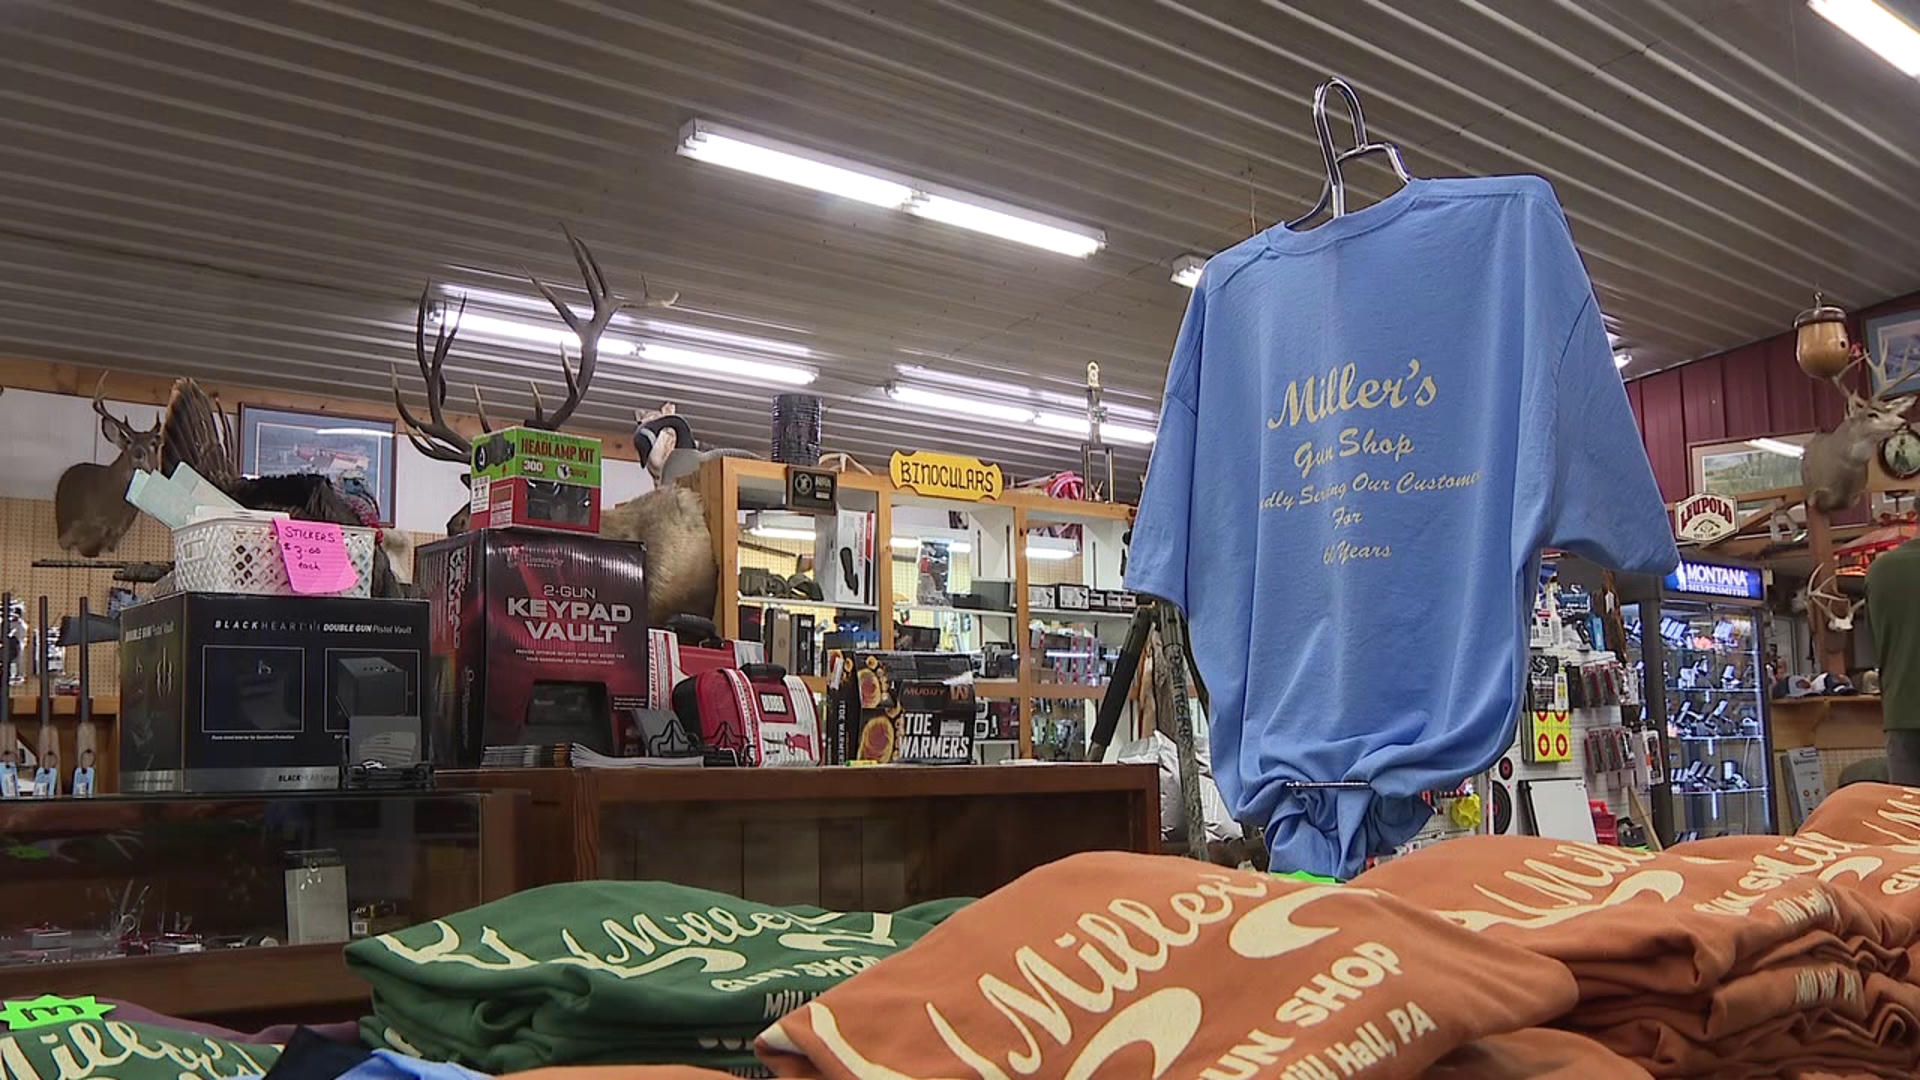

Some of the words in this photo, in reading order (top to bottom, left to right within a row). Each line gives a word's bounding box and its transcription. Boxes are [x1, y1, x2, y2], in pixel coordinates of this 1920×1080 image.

[1266, 358, 1438, 430] Miller's
[521, 438, 577, 460] HEADLAMP
[578, 447, 595, 464] KIT
[1294, 441, 1334, 478] Gun
[1339, 428, 1415, 462] Shop
[522, 460, 544, 473] 300
[899, 459, 995, 492] BINOCULARS
[1352, 471, 1391, 492] Our
[1331, 506, 1363, 530] For
[1680, 497, 1733, 532] LEUPOLD
[284, 526, 336, 543] STICKERS
[1336, 539, 1393, 565] Years
[298, 561, 322, 571] each
[1685, 563, 1748, 587] MONTANA
[506, 597, 633, 623] KEYPAD
[323, 623, 355, 633] DOUBLE
[355, 624, 373, 634] GUN
[524, 619, 619, 644] VAULT
[905, 713, 934, 735] TOE
[899, 736, 970, 759] WARMERS
[1197, 1028, 1296, 1080] UN
[1274, 941, 1404, 1028] SHOP
[1324, 1021, 1398, 1078] Hall,
[1386, 1000, 1438, 1045] PA
